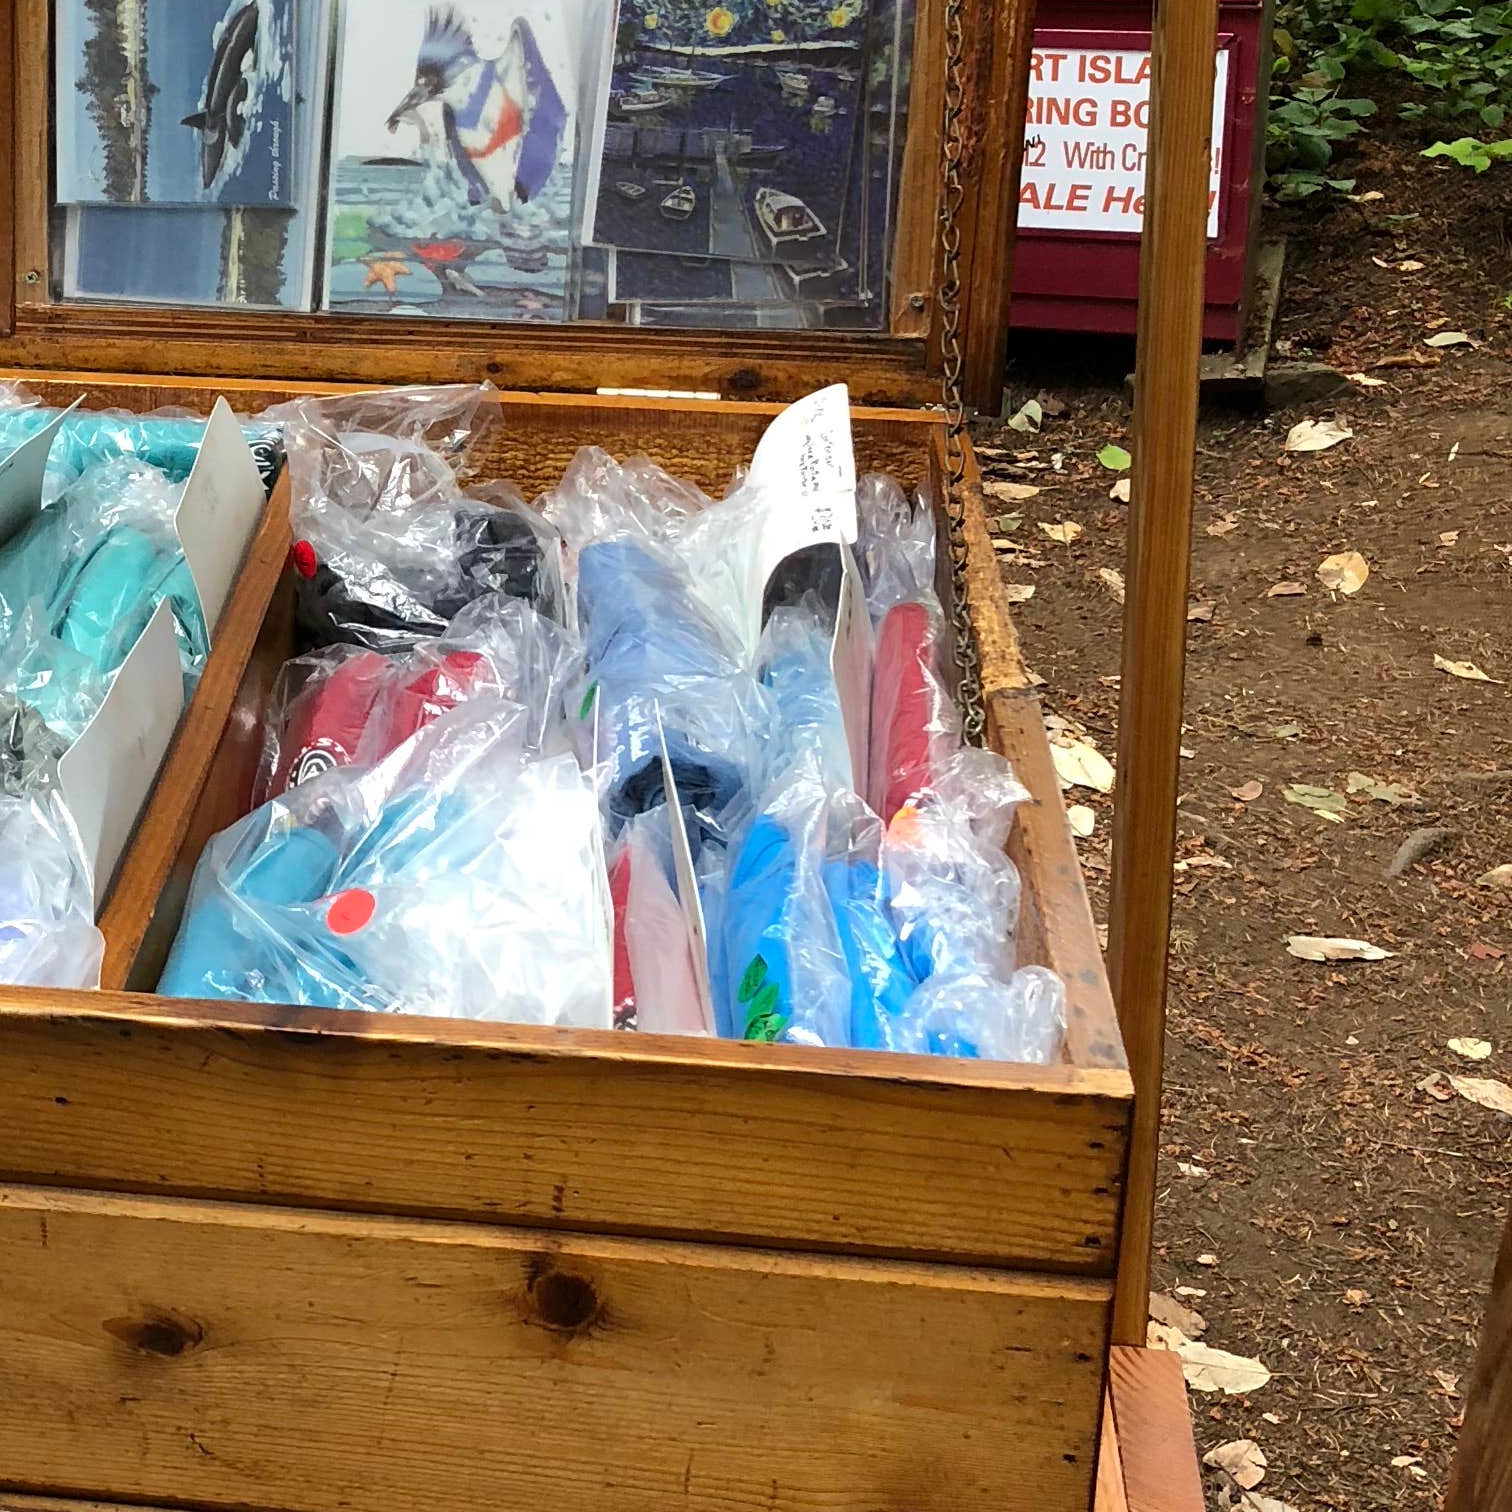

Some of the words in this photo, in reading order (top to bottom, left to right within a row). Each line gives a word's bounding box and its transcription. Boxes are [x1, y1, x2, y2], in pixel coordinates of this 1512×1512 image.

[1077, 53, 1152, 84] ISLA
[1063, 140, 1115, 171] With
[268, 160, 282, 201] Passing
[1018, 181, 1093, 212] ALE
